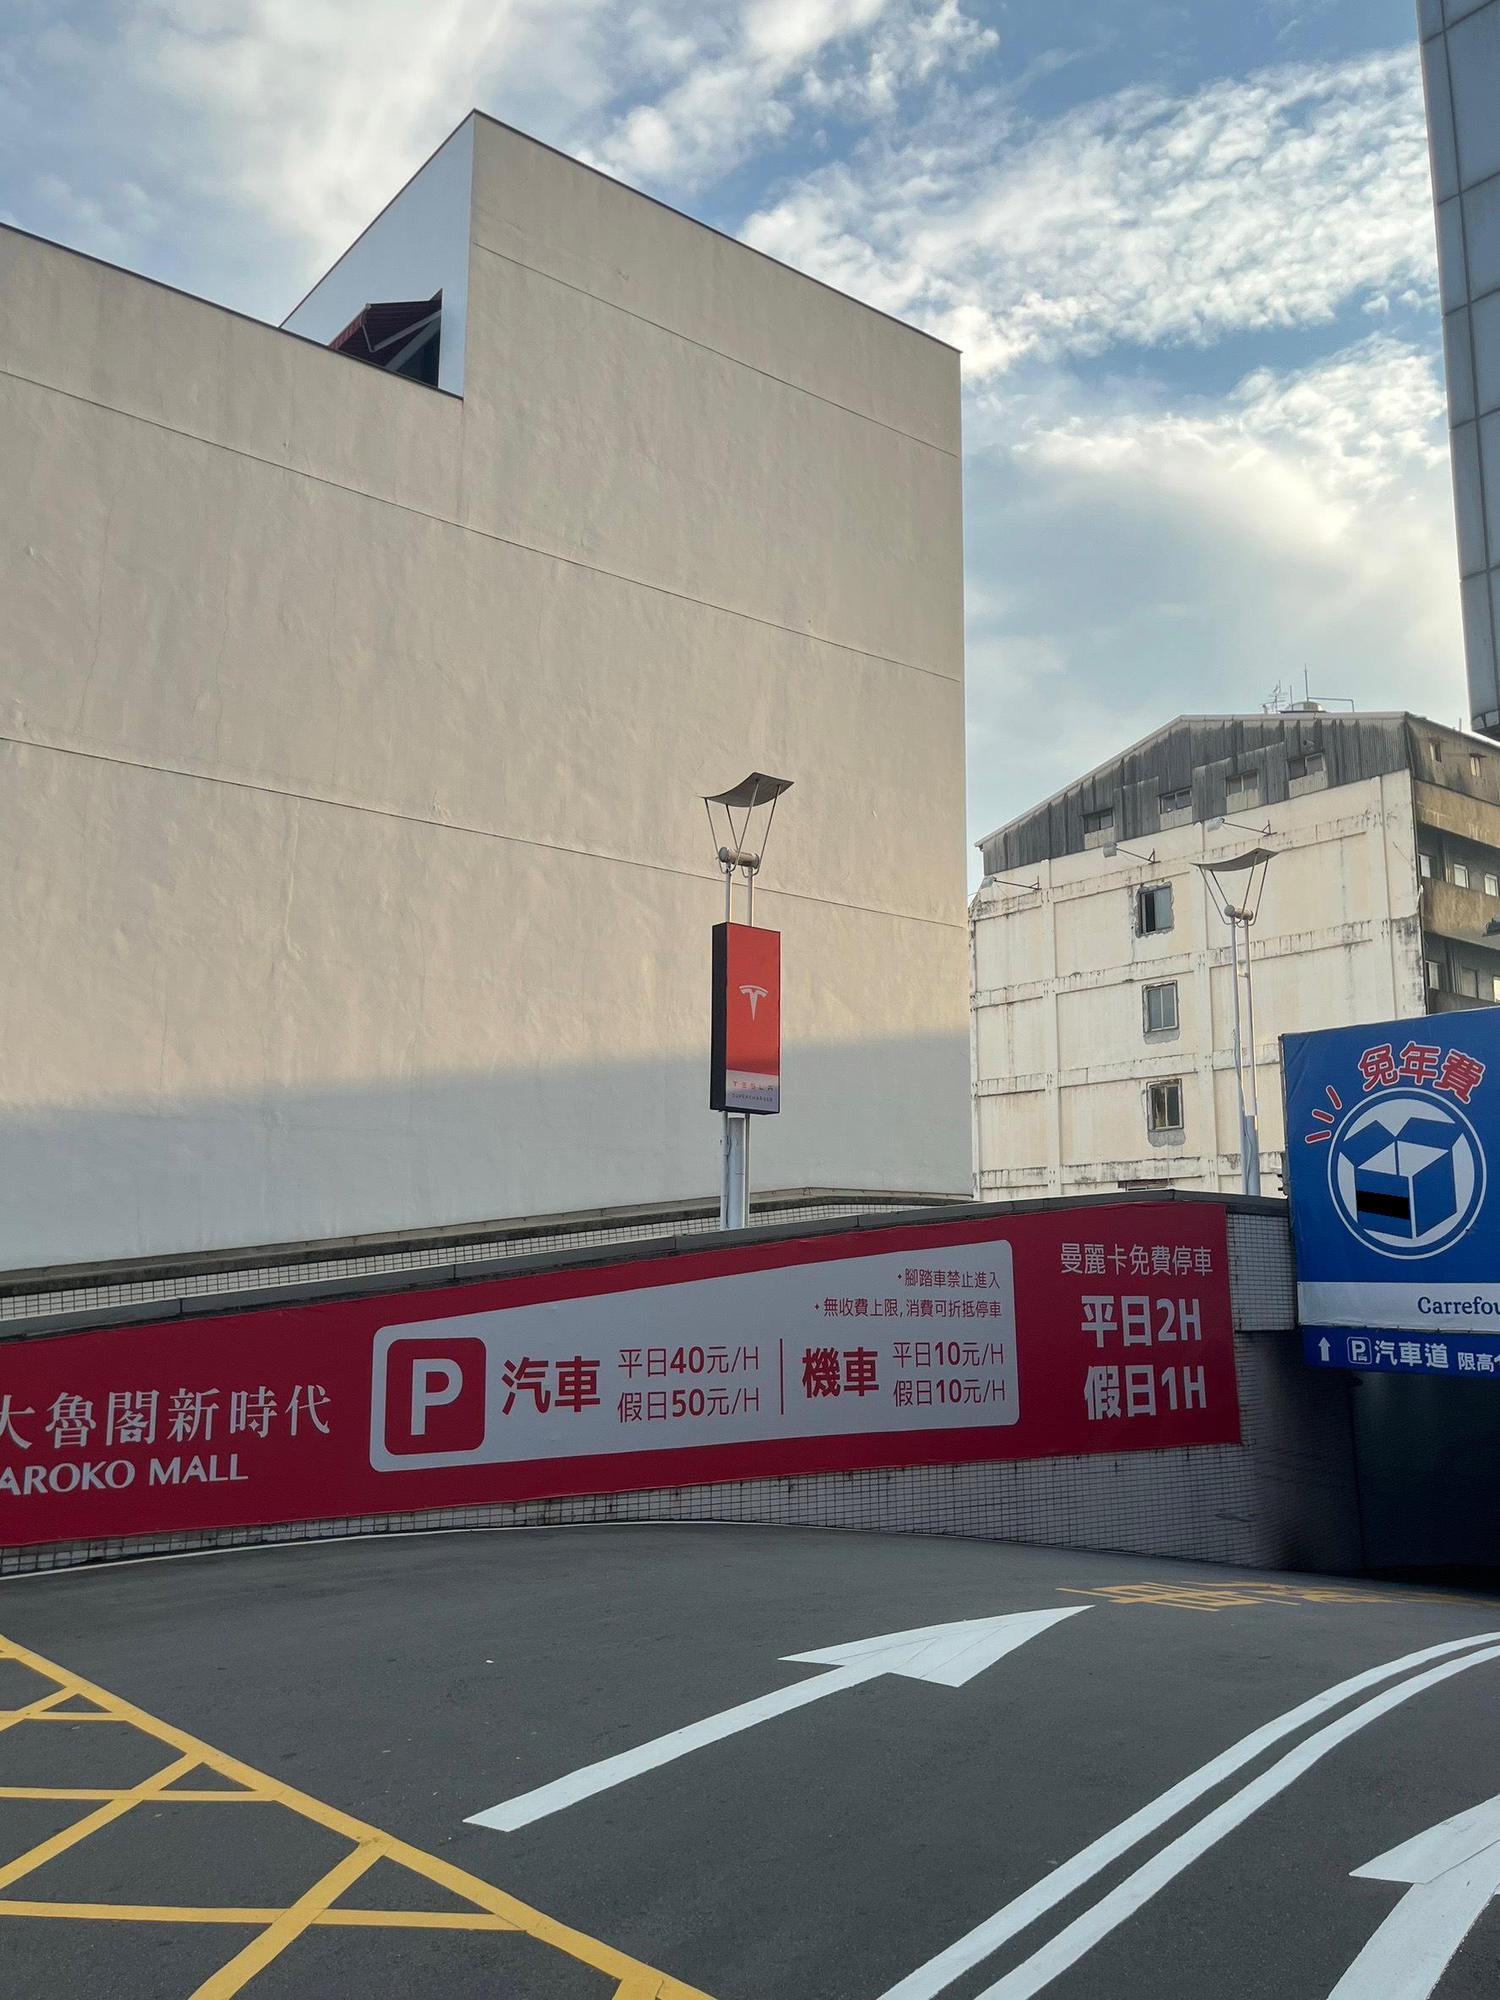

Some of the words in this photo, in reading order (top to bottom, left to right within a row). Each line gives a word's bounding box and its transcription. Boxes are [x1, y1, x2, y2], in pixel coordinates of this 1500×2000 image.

[1358, 1041, 1486, 1104] 免年費
[904, 1267, 1000, 1289] 腳踏車禁止進入
[1060, 1243, 1213, 1276] 曼麗卡免費停車
[1081, 1295, 1202, 1348] 平日2H
[618, 1345, 760, 1379] 平日40元/H
[802, 1346, 880, 1399] 機車
[892, 1341, 1004, 1369] 平日10元/H
[1374, 1339, 1449, 1369] 汽車道
[410, 1358, 464, 1436] P
[501, 1355, 600, 1415] 汽車
[617, 1387, 760, 1423] 假日50元/H
[893, 1379, 1006, 1407] 假日10元/H
[1084, 1365, 1207, 1420] 假日1H
[0, 1384, 331, 1450] 大魯閣新時代
[0, 1459, 136, 1496] AROKO
[149, 1453, 249, 1486] MALL
